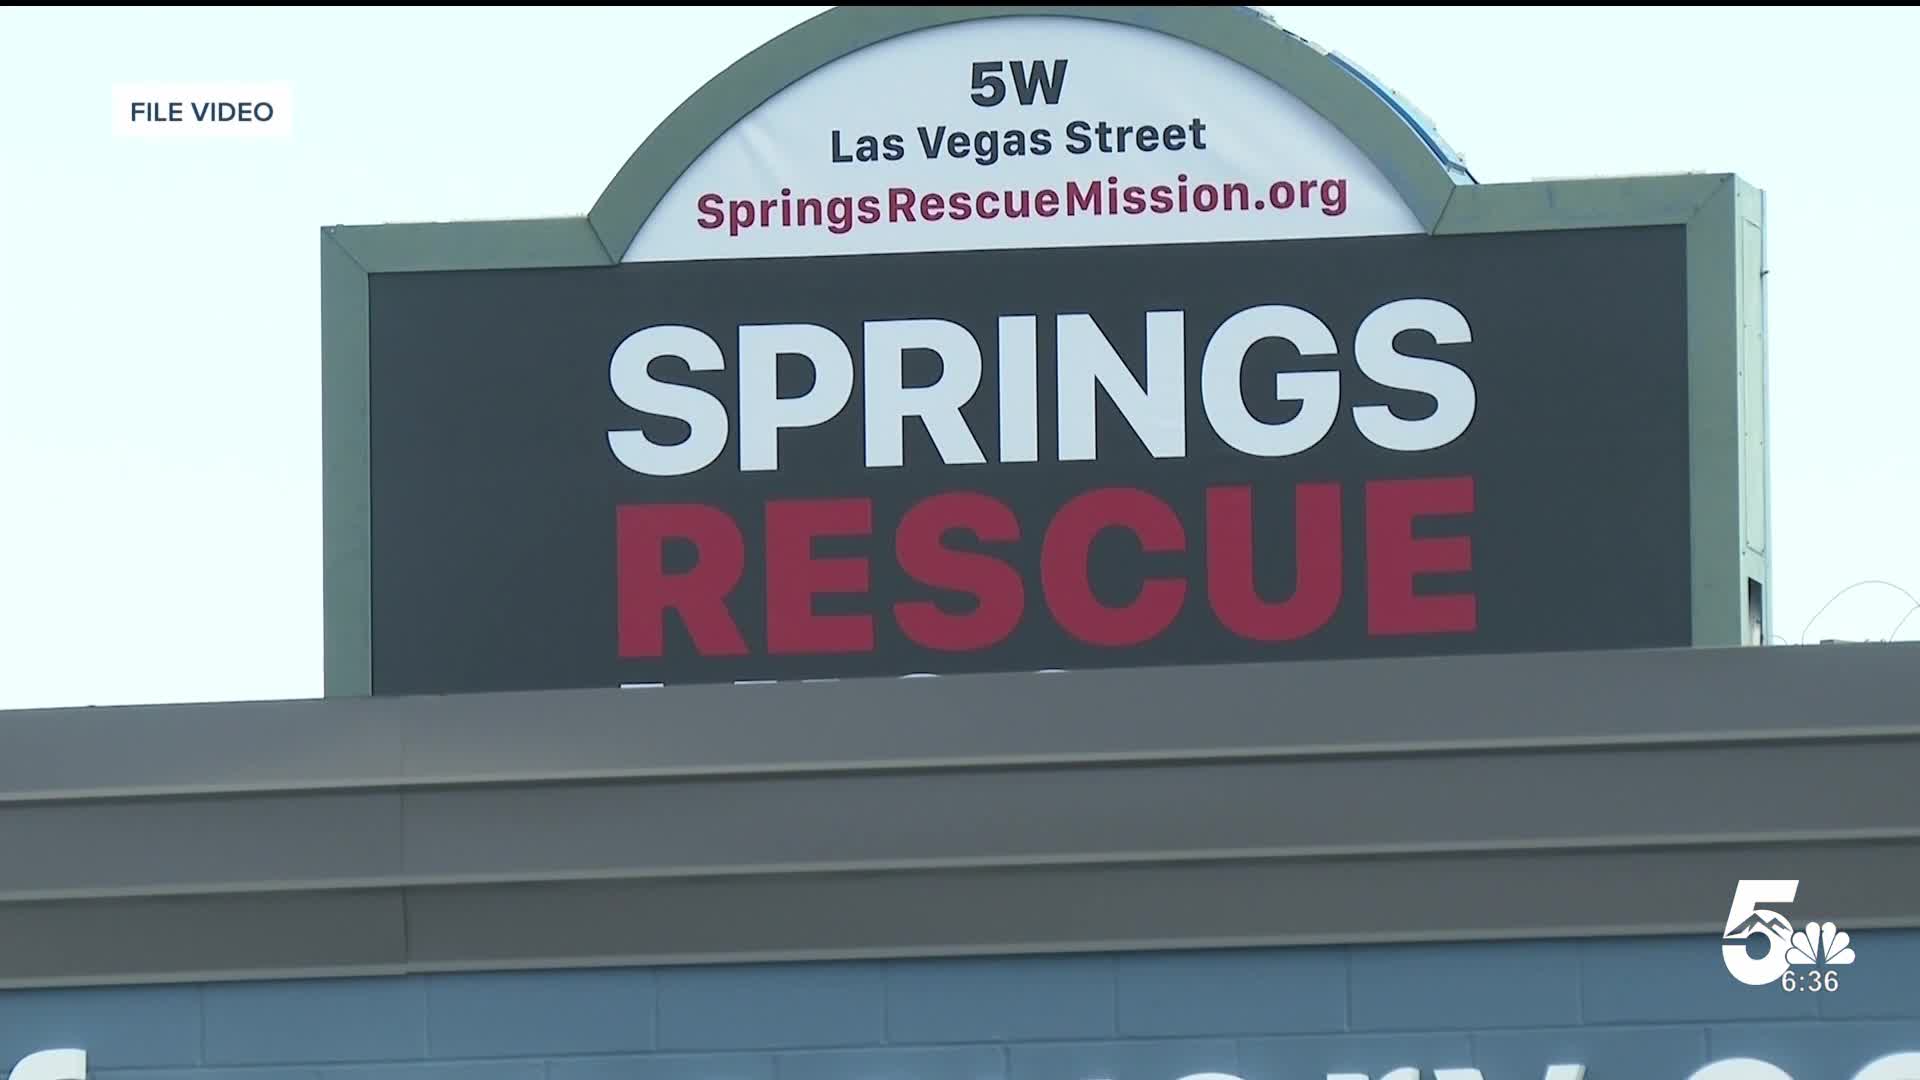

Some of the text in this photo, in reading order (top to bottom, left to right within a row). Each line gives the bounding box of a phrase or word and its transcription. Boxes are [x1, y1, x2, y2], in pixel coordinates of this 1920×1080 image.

[970, 59, 1069, 107] 5W
[831, 118, 1207, 166] Las Vegas Street
[697, 174, 1348, 236] SpringsRescueMission.org
[608, 299, 1476, 476] SPRINGS
[616, 476, 1477, 657] RESCUE
